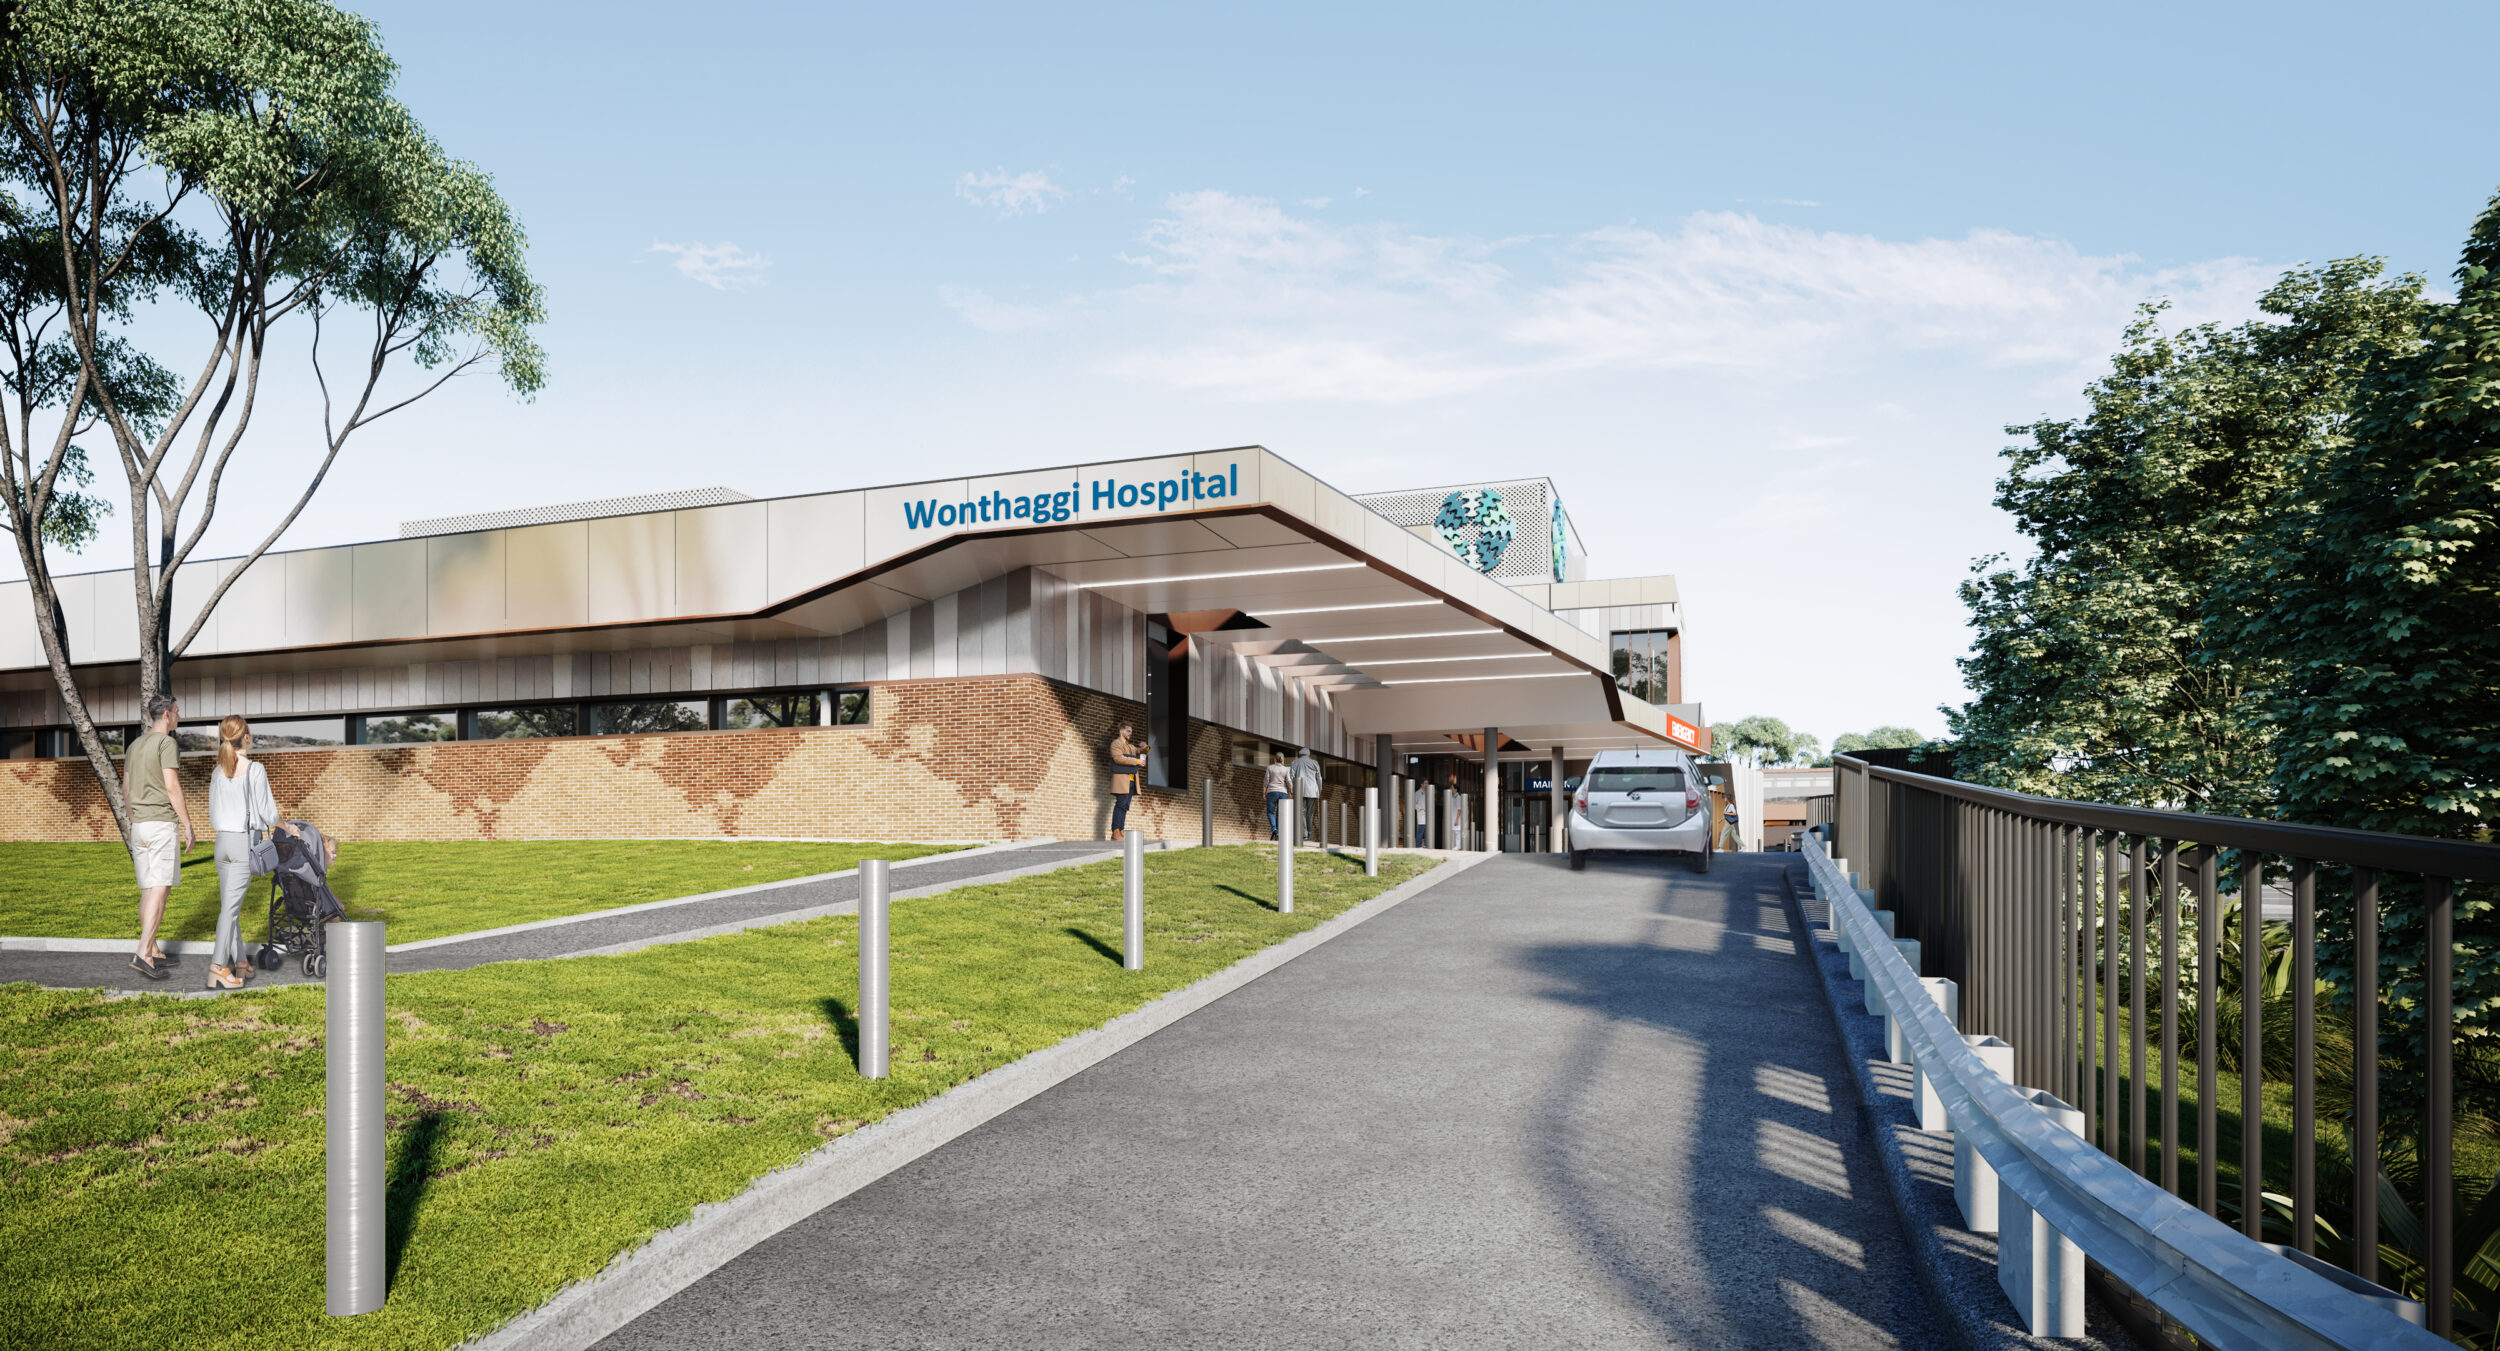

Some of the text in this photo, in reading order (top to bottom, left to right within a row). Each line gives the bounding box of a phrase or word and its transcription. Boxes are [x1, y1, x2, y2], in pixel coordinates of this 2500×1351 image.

[903, 463, 1238, 530] Wonthaggi Hospital
[1533, 780, 1552, 789] MAI
